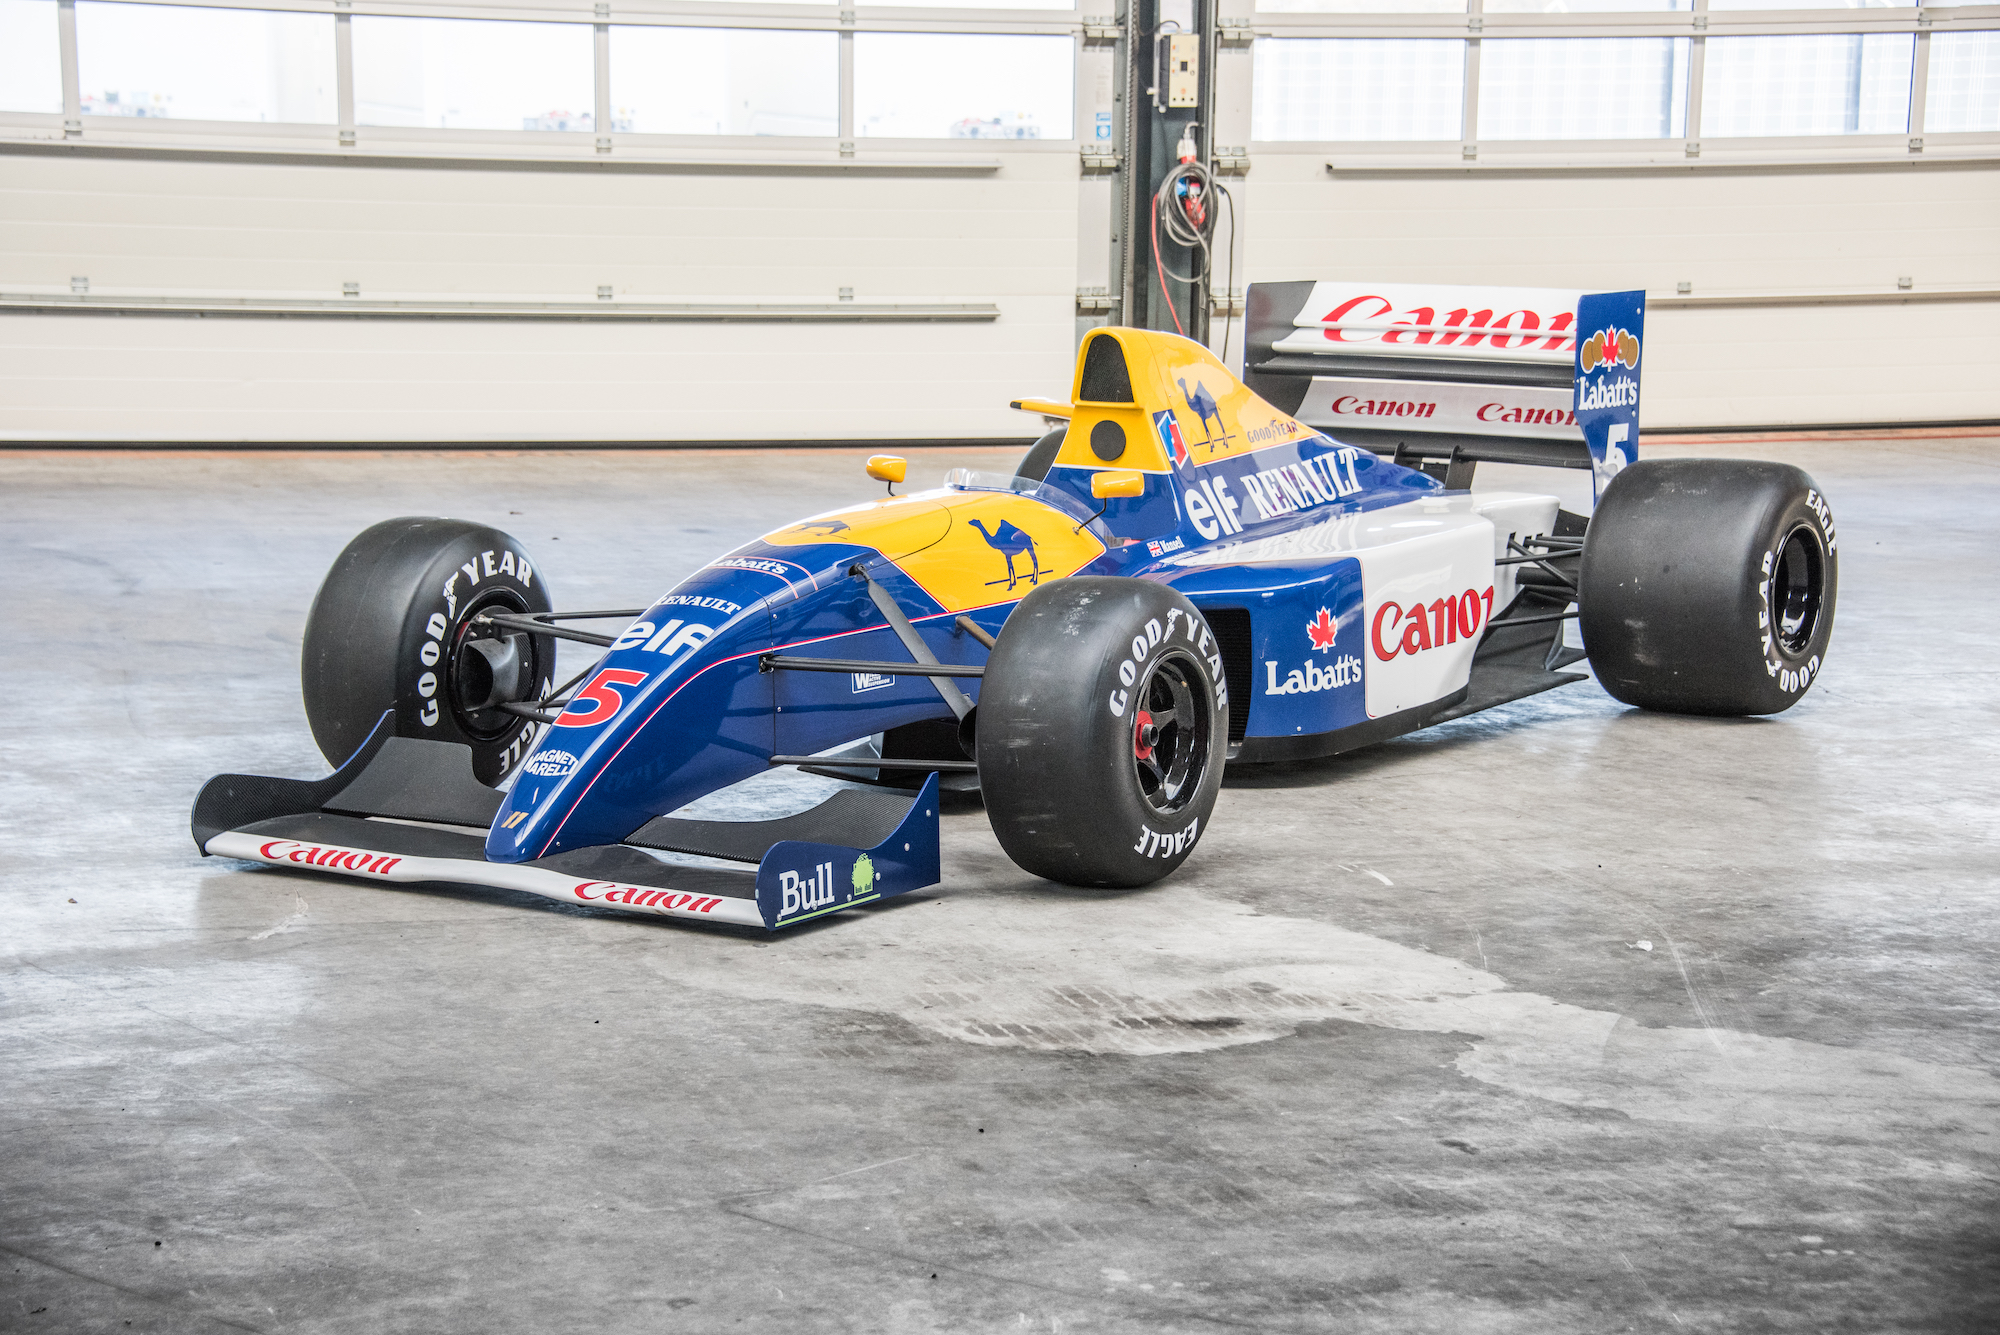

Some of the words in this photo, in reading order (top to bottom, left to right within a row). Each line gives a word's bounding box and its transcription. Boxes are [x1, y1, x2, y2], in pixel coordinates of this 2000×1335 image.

[1332, 395, 1437, 418] Canon
[1578, 375, 1638, 411] Labatt's
[1601, 422, 1630, 493] 5
[1184, 475, 1244, 541] elf
[1240, 448, 1363, 520] RENAULT
[1805, 489, 1838, 557] EAGLE
[609, 618, 715, 657] elf
[1265, 653, 1362, 695] Labatt's
[551, 667, 650, 729] 5
[259, 840, 402, 875] Canon
[1133, 816, 1199, 859] EAGLE
[574, 881, 723, 913] Canon
[778, 861, 835, 917] Bull
